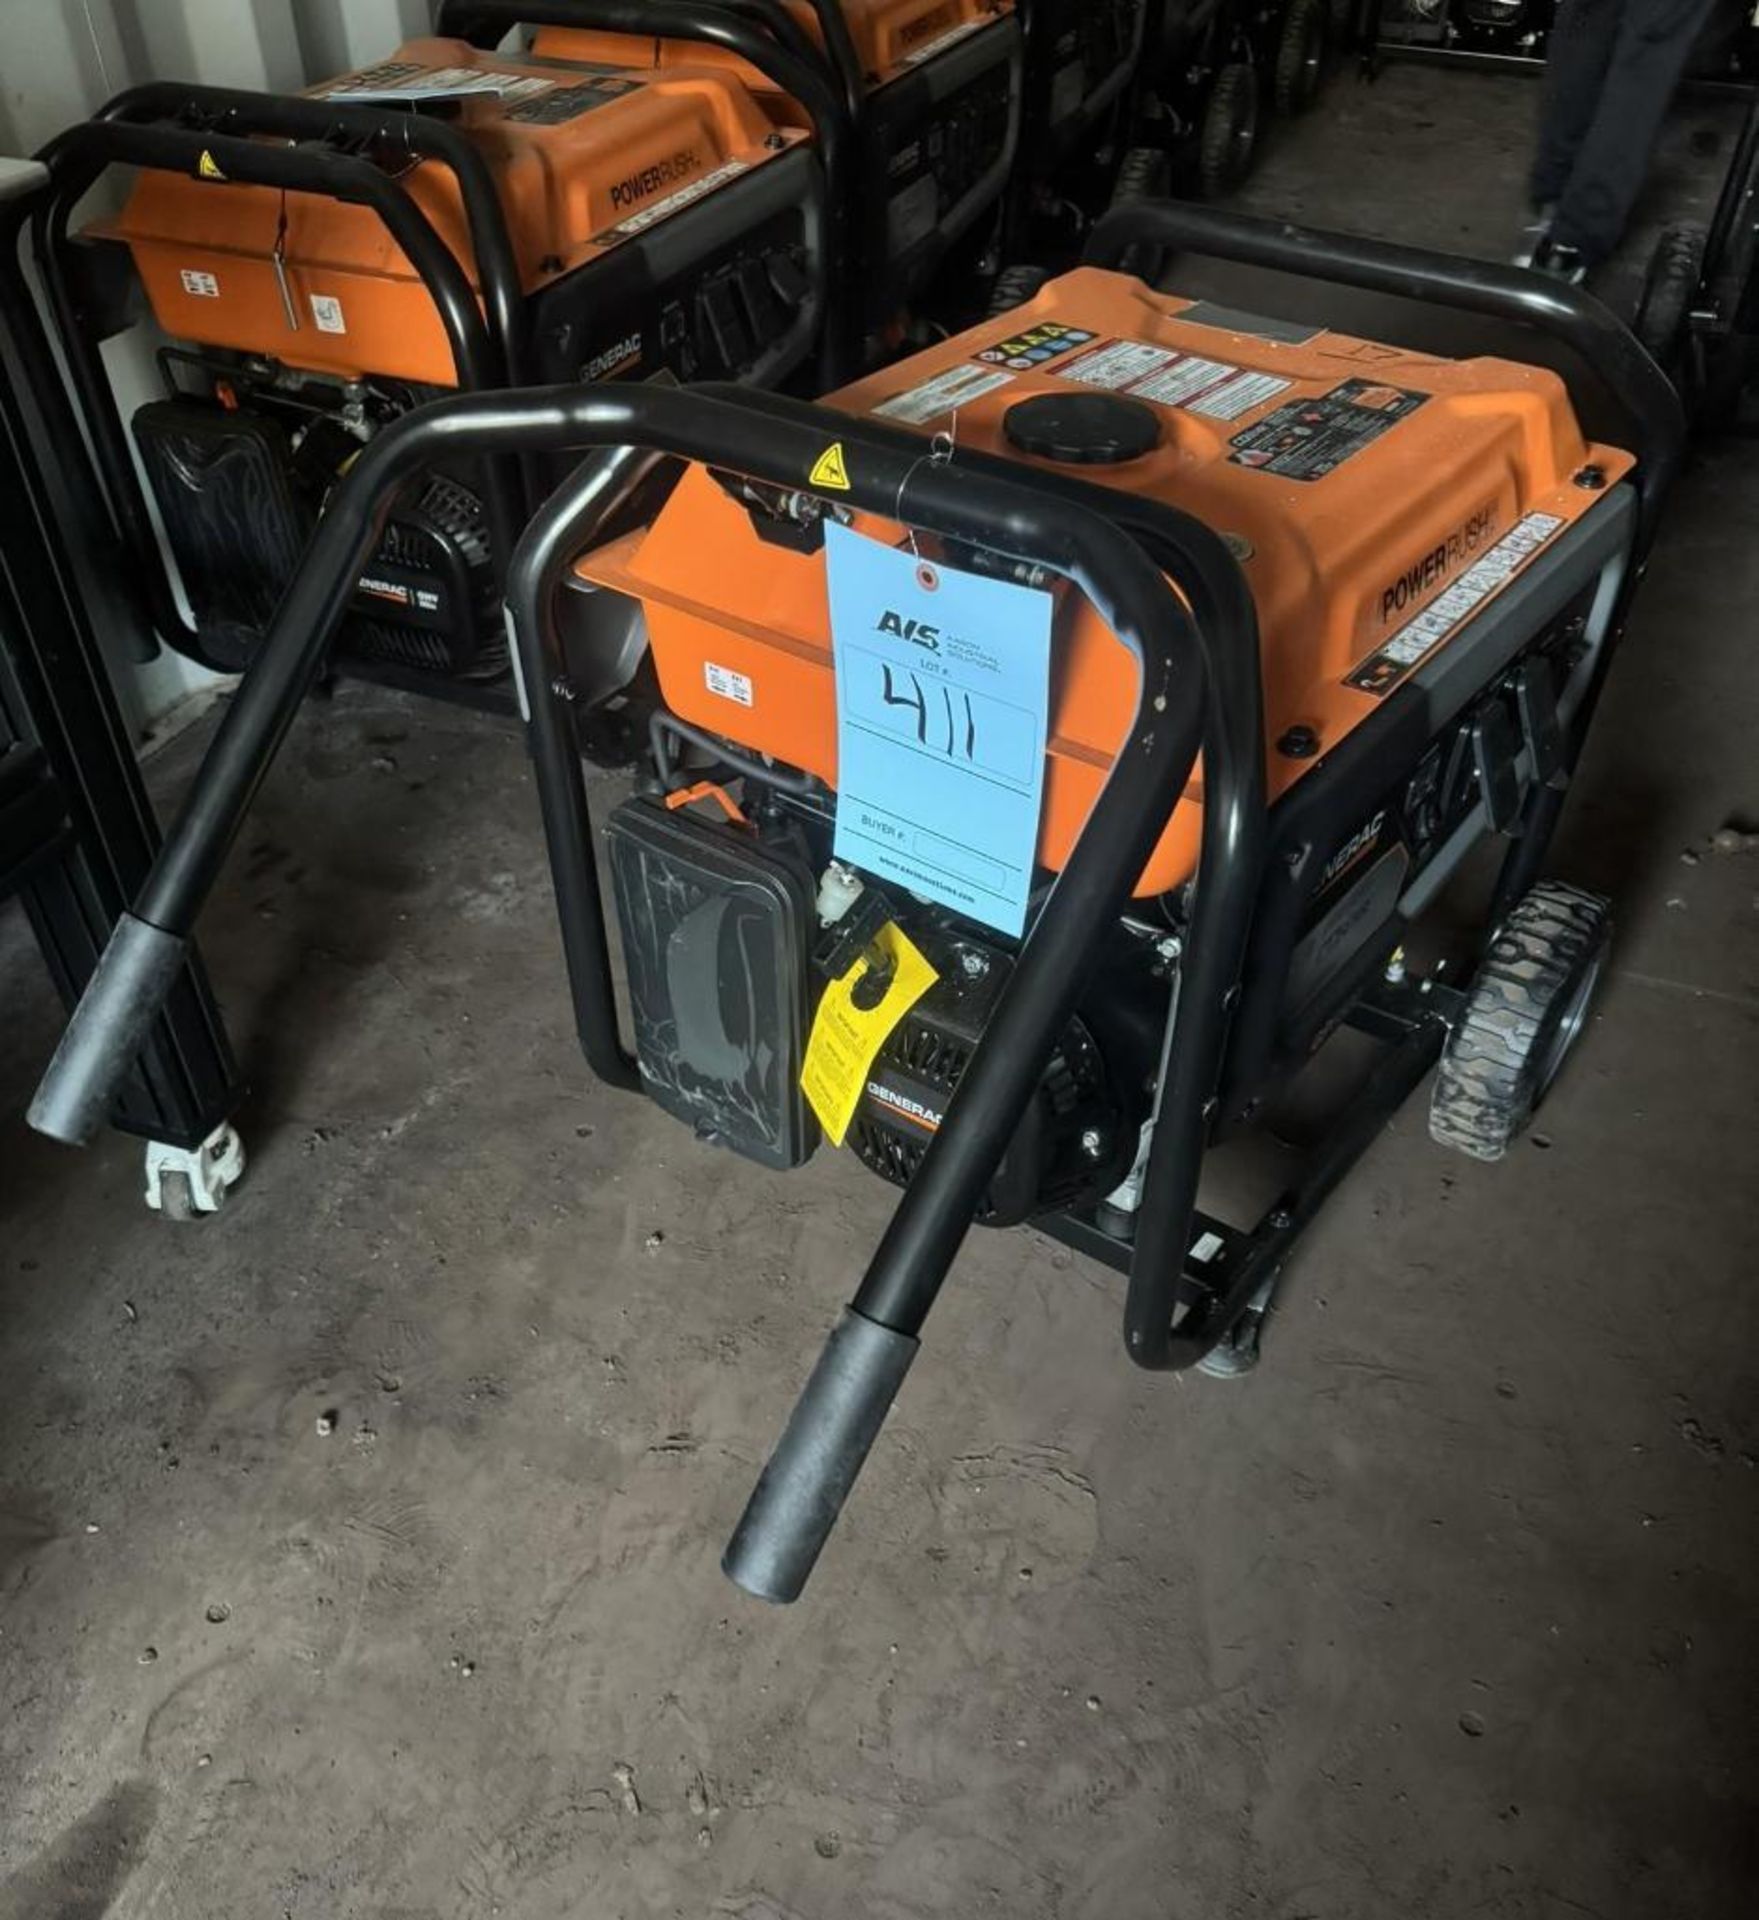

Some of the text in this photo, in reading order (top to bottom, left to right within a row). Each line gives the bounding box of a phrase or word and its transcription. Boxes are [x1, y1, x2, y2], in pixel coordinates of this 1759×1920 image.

[610, 152, 697, 211] POWERRUSH
[1383, 508, 1489, 624] POWERRUSH
[876, 611, 942, 657] AIS
[920, 658, 940, 674] LOT
[881, 663, 975, 761] 411
[861, 814, 896, 837] BUYER
